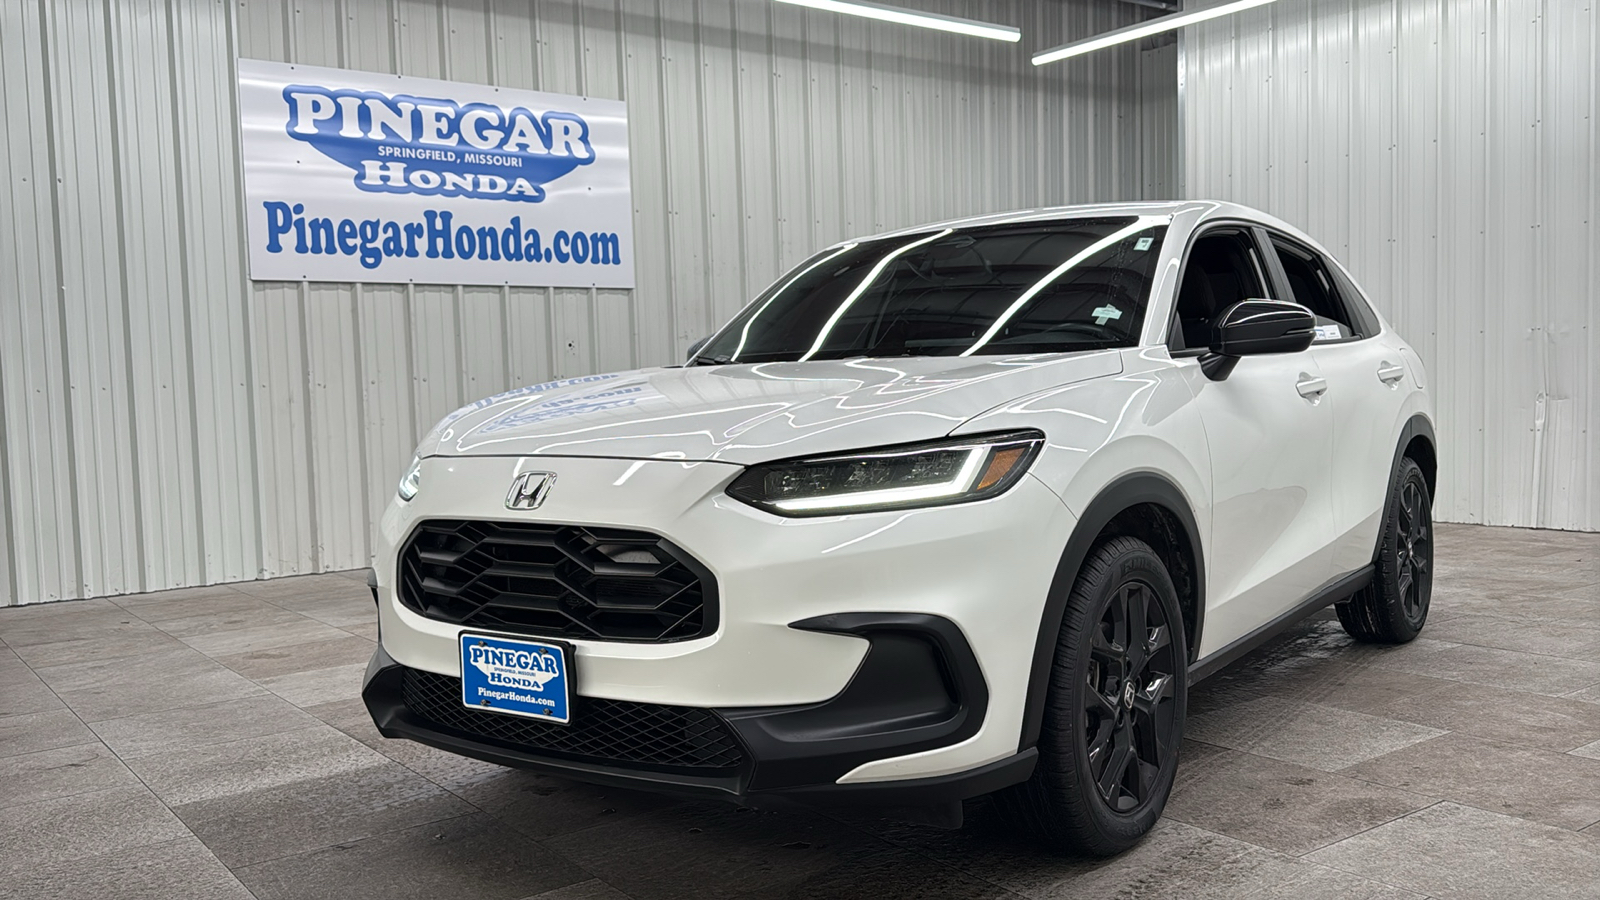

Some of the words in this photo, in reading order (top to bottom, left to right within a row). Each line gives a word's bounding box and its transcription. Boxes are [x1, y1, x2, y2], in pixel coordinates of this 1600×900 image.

[290, 92, 590, 159] PINEGAR
[377, 145, 461, 165] SPRINGFIELD,
[464, 152, 522, 168] MISSOURI
[361, 160, 540, 197] HONDA
[263, 201, 621, 269] PinegarHonda.com
[471, 648, 557, 674] PINEGAR
[490, 672, 541, 688] HONDA
[478, 687, 555, 707] PinegarHonda.com
